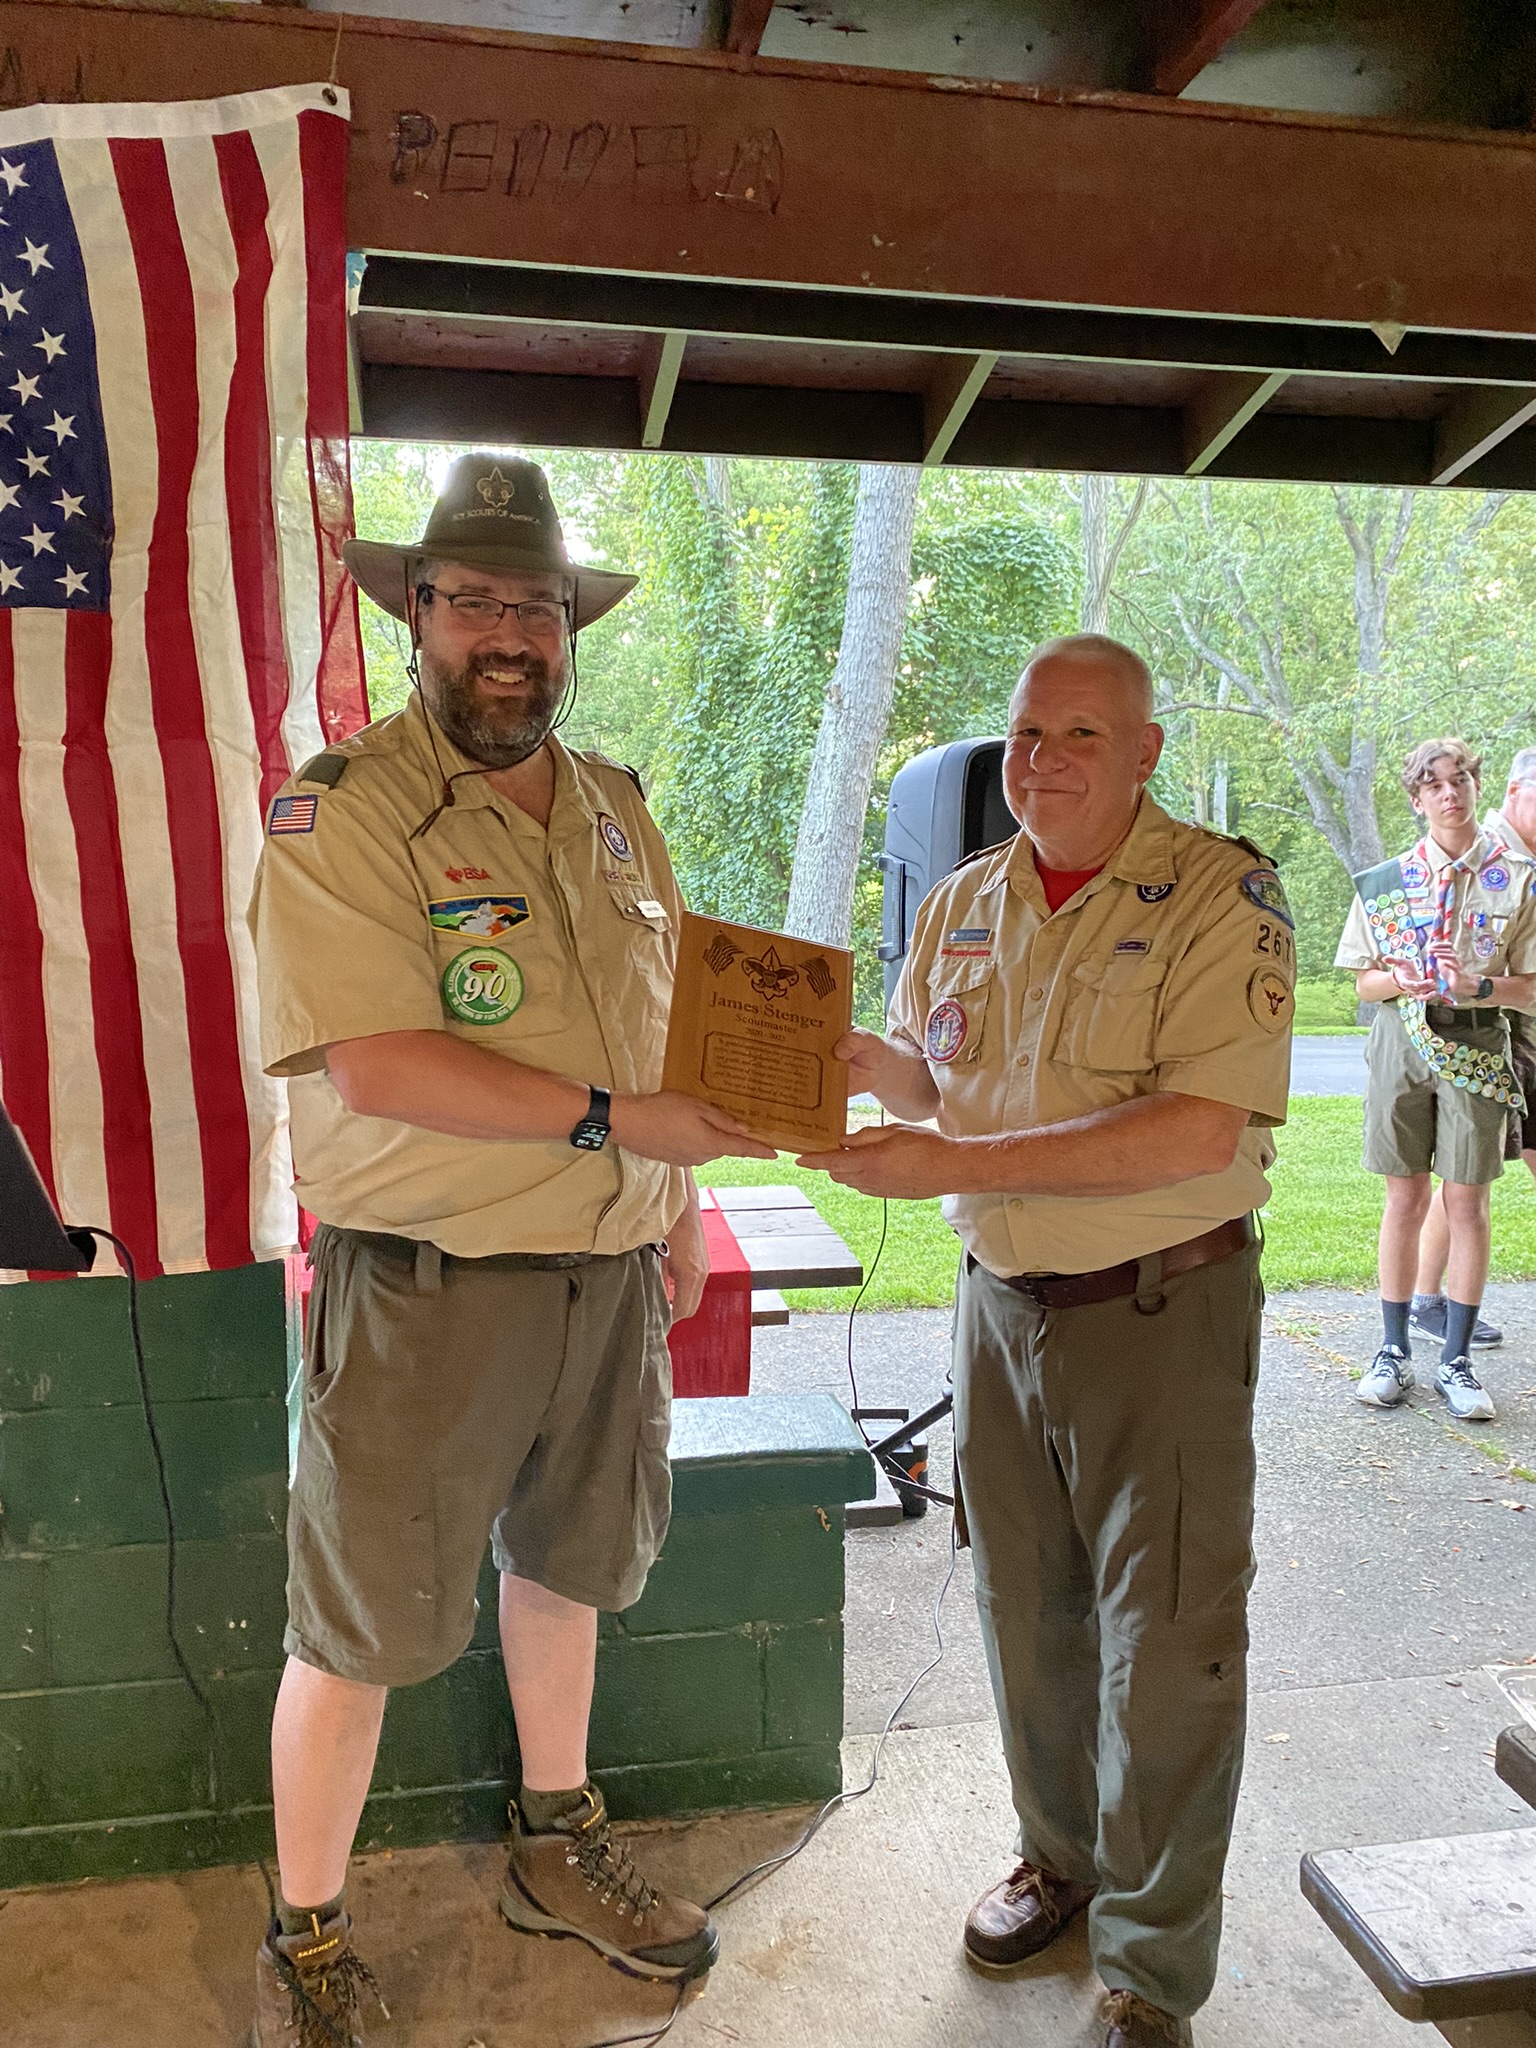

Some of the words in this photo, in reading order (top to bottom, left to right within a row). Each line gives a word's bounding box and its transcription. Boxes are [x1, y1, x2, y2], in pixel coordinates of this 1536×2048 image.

[466, 508, 496, 518] SCOUTS
[497, 509, 508, 517] OF
[463, 867, 492, 881] BSA
[1257, 924, 1291, 961] 267
[461, 973, 507, 1003] 90
[709, 991, 759, 1014] James
[764, 1003, 826, 1029] Stenger
[735, 1013, 797, 1035] Scoutmaster
